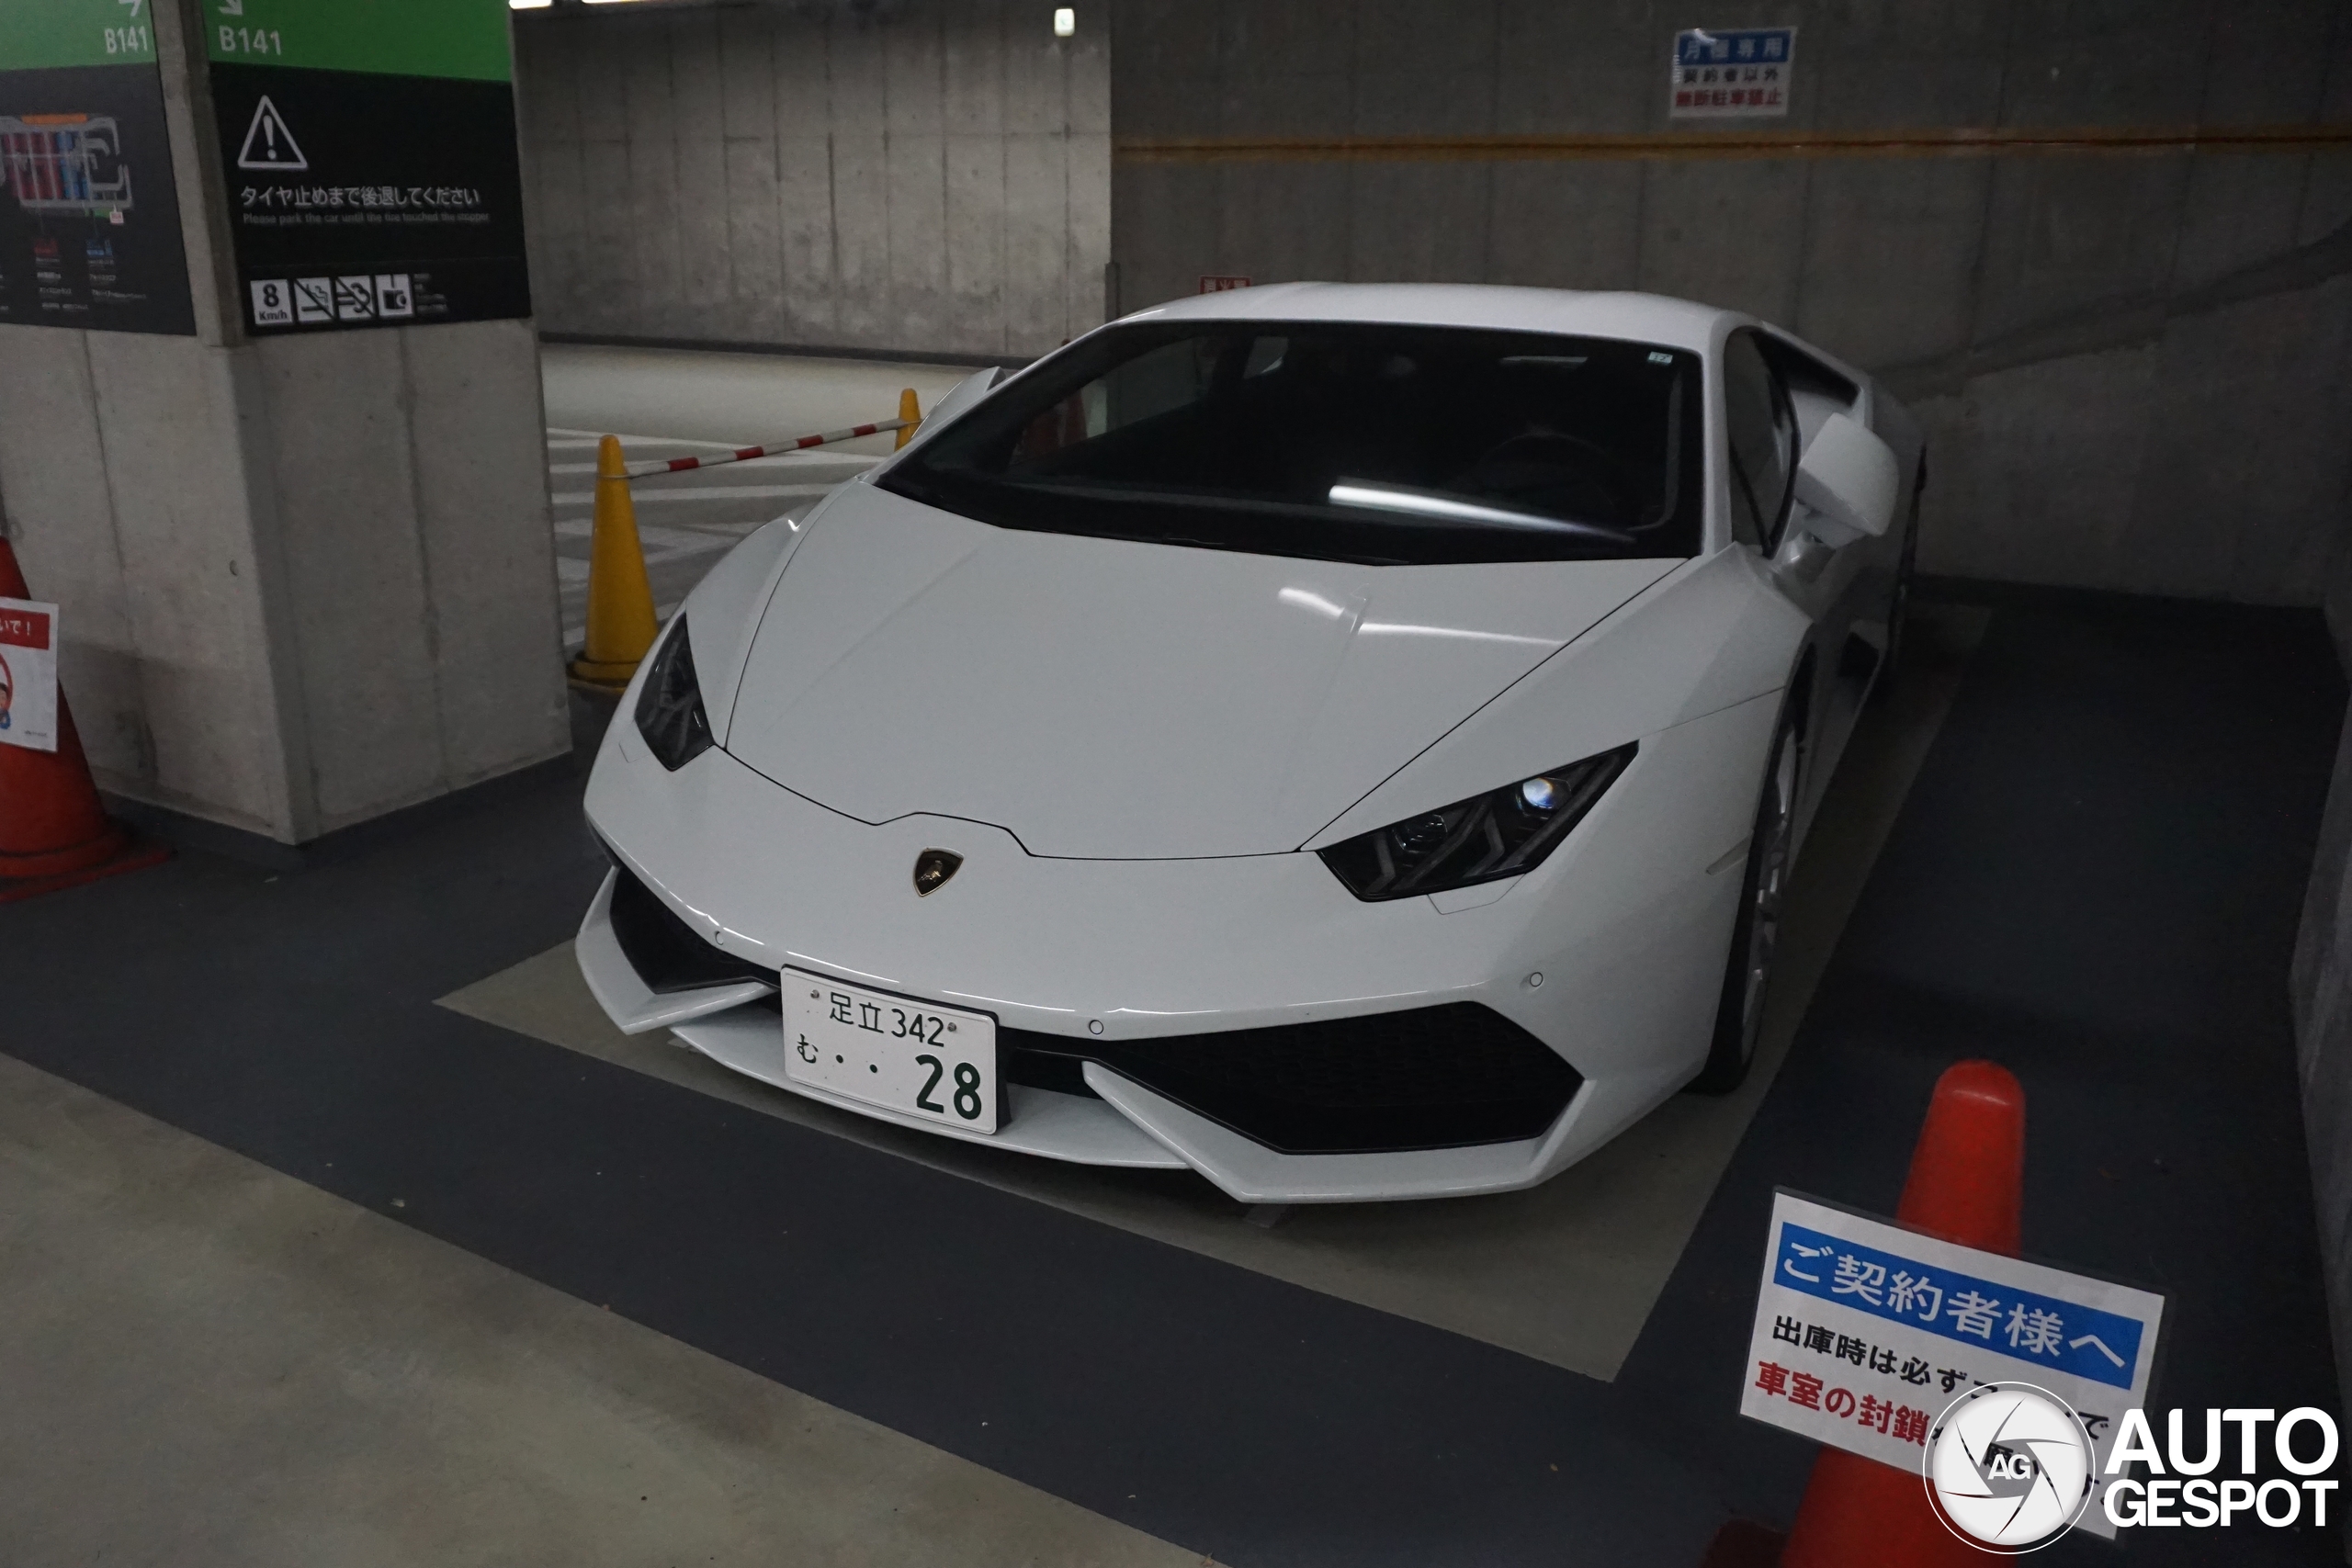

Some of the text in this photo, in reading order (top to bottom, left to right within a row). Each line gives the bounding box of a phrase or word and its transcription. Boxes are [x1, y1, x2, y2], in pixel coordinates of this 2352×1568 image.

[104, 26, 148, 54] B141
[219, 25, 282, 56] B141
[241, 185, 481, 206] タイヤ止めまで後退してください
[243, 212, 276, 223] Please
[279, 212, 301, 225] park
[305, 212, 322, 223] the
[263, 283, 279, 308] 8
[258, 310, 288, 321] Km/h
[797, 1033, 819, 1064] む
[1783, 1241, 2126, 1369] ご契約者様へ
